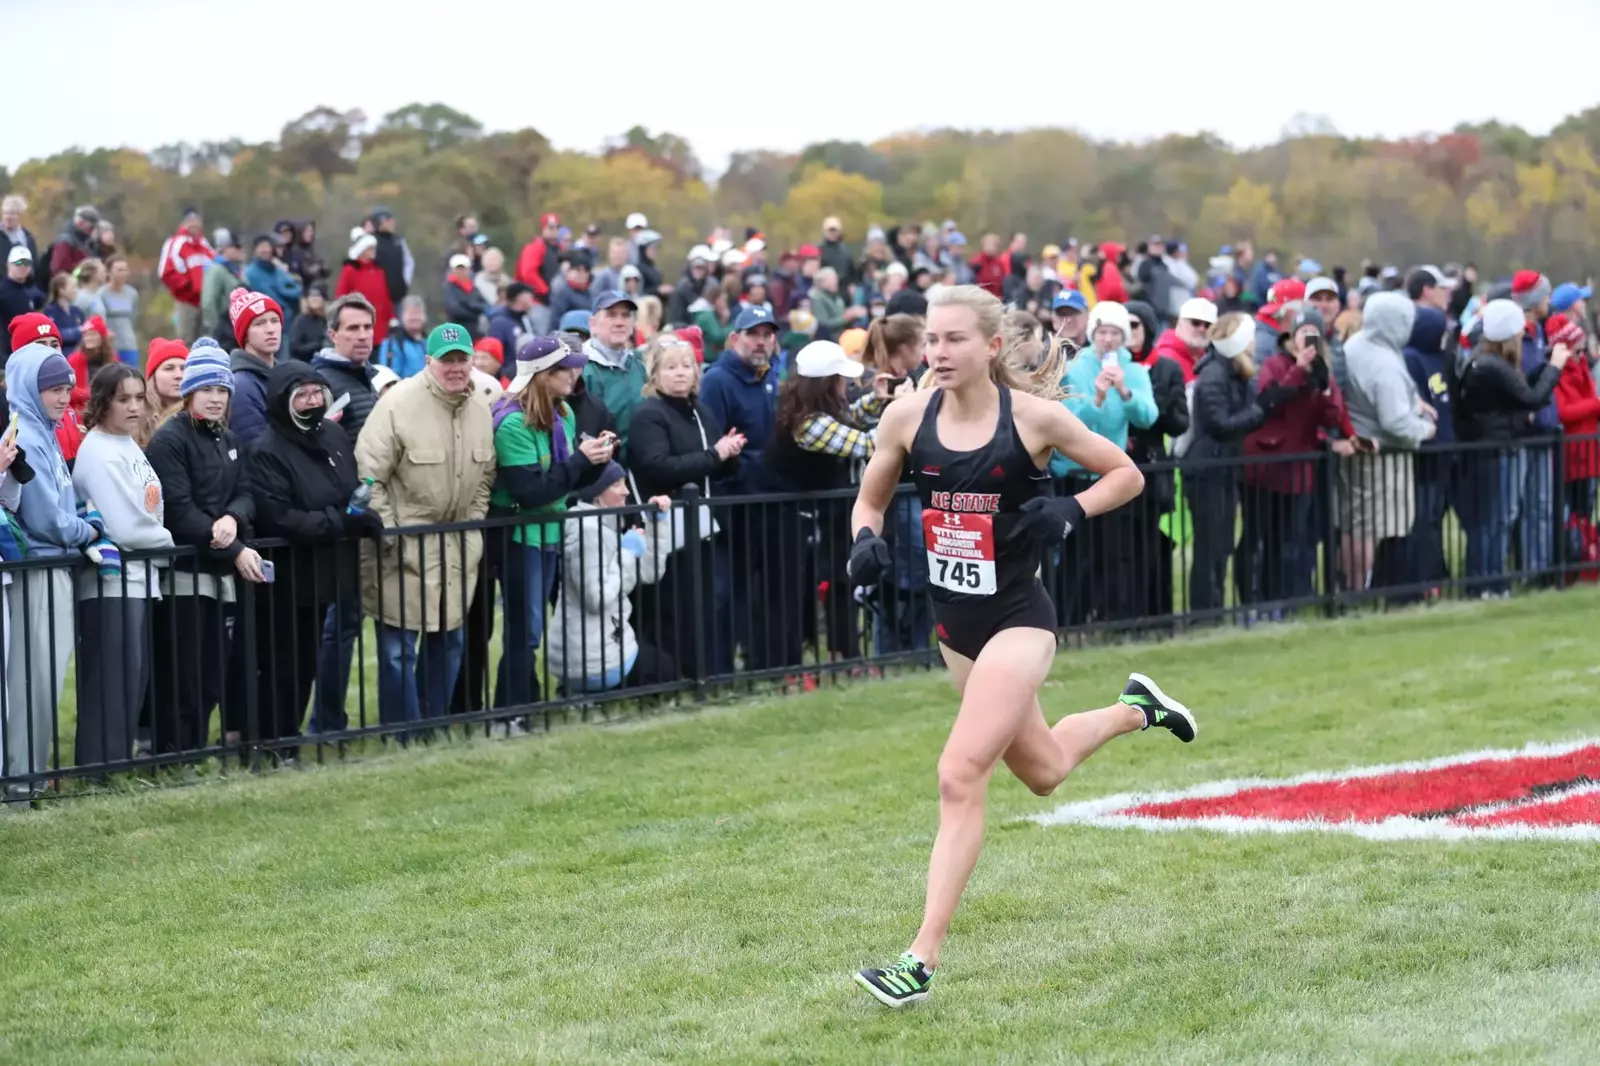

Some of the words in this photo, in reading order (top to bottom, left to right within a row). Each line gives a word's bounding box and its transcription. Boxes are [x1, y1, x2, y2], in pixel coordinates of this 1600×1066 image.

[931, 490, 951, 509] NC
[951, 492, 1001, 512] STATE
[936, 558, 981, 589] 745
